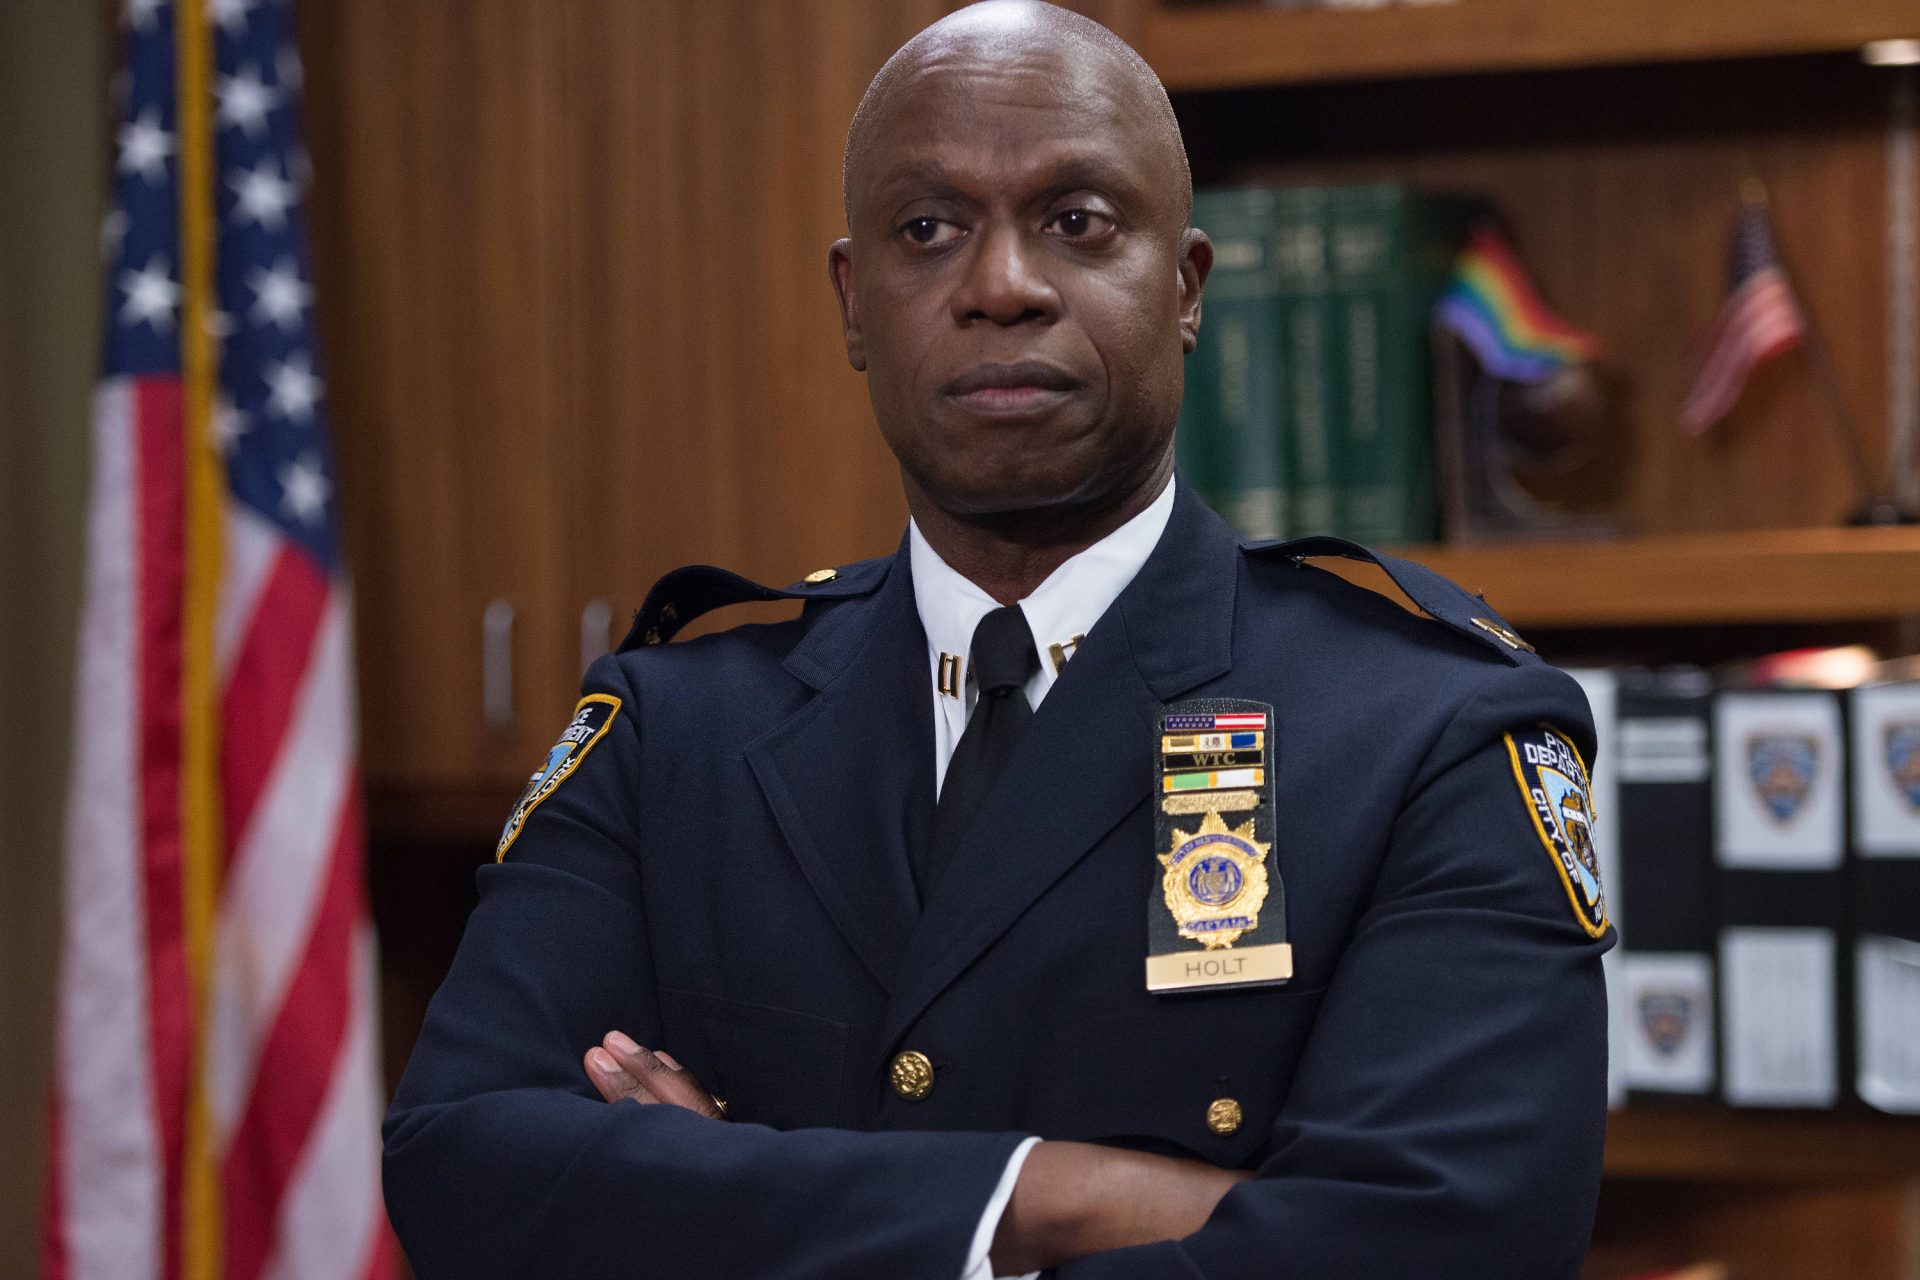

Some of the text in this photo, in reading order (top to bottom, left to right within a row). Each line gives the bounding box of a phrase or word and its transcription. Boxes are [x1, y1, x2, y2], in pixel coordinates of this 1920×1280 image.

[1193, 752, 1236, 767] WTC
[529, 757, 576, 802] YORK
[1531, 788, 1563, 844] CITY
[1561, 851, 1581, 885] OF
[1186, 917, 1247, 931] CAPTAIN
[1185, 957, 1248, 979] HOLT
